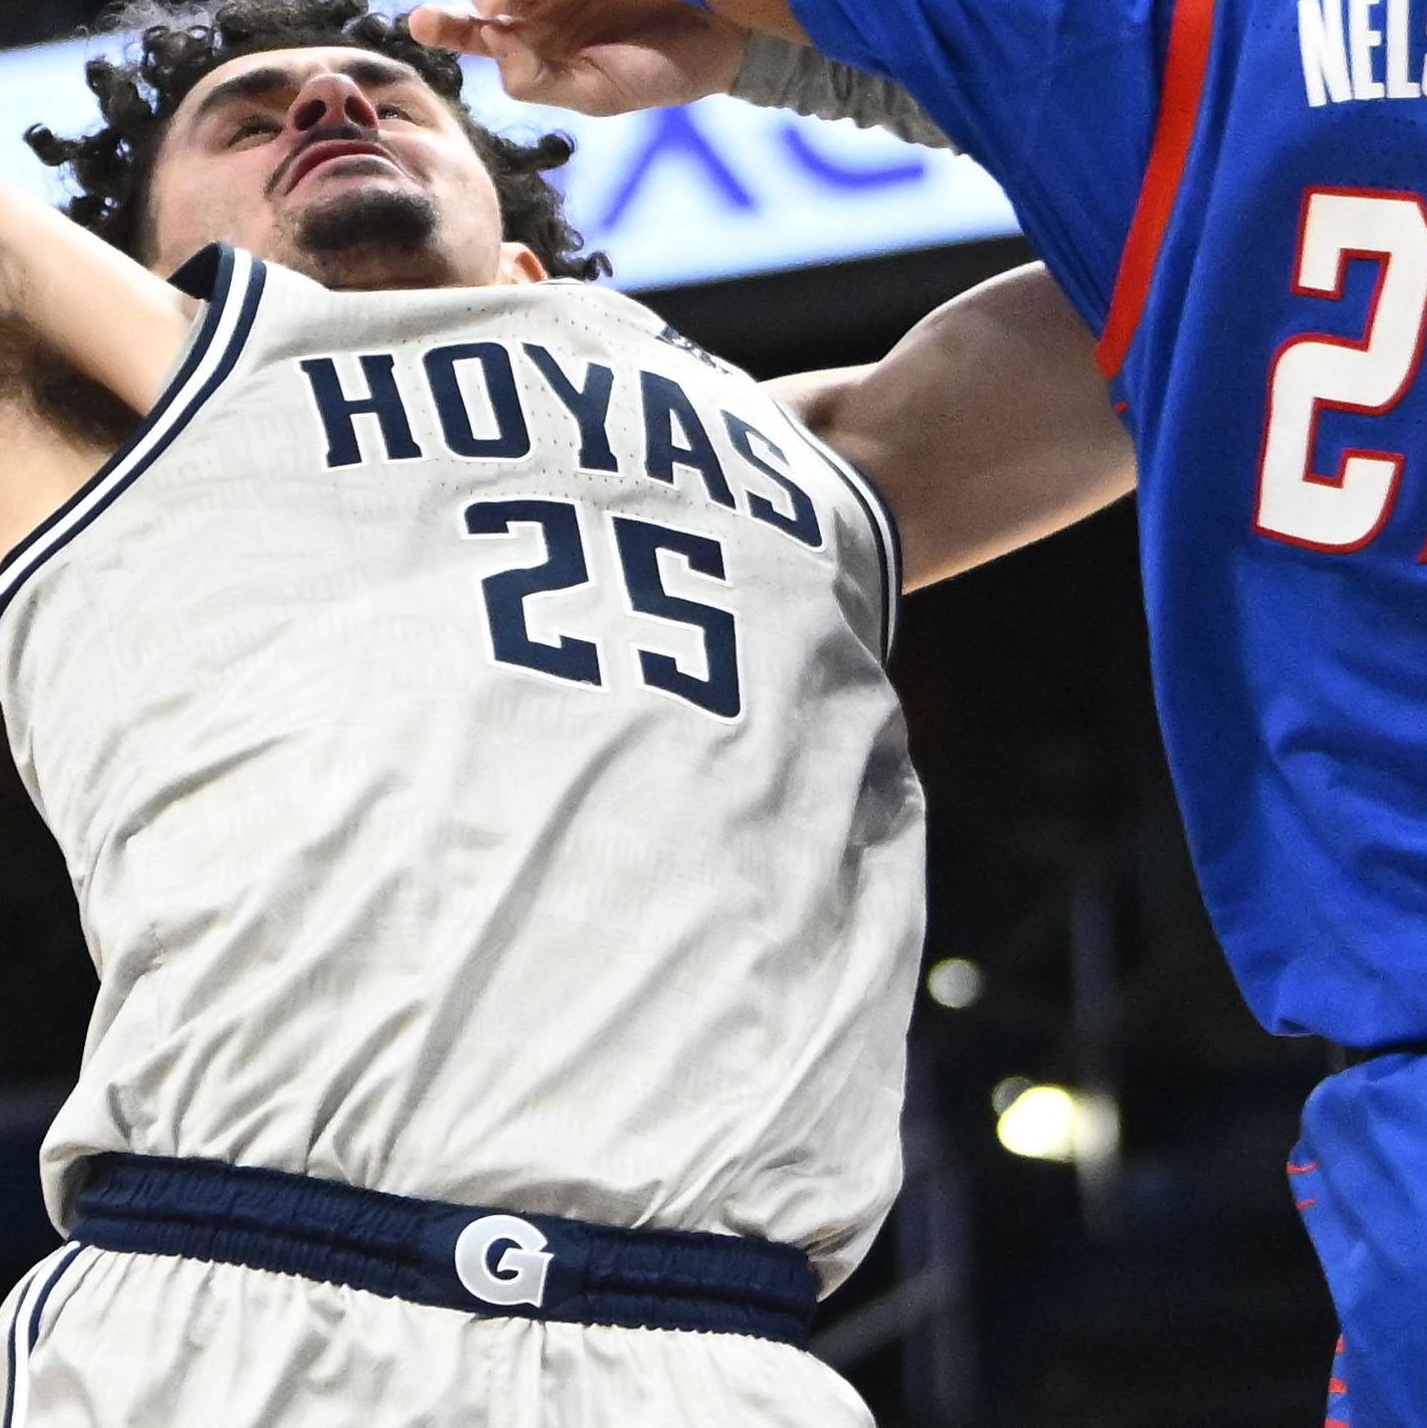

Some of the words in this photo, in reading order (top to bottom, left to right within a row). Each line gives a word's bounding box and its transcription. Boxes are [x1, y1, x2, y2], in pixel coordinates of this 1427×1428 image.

[298, 340, 826, 550] HOYAS
[461, 498, 744, 725] 25
[455, 1214, 554, 1308] G
